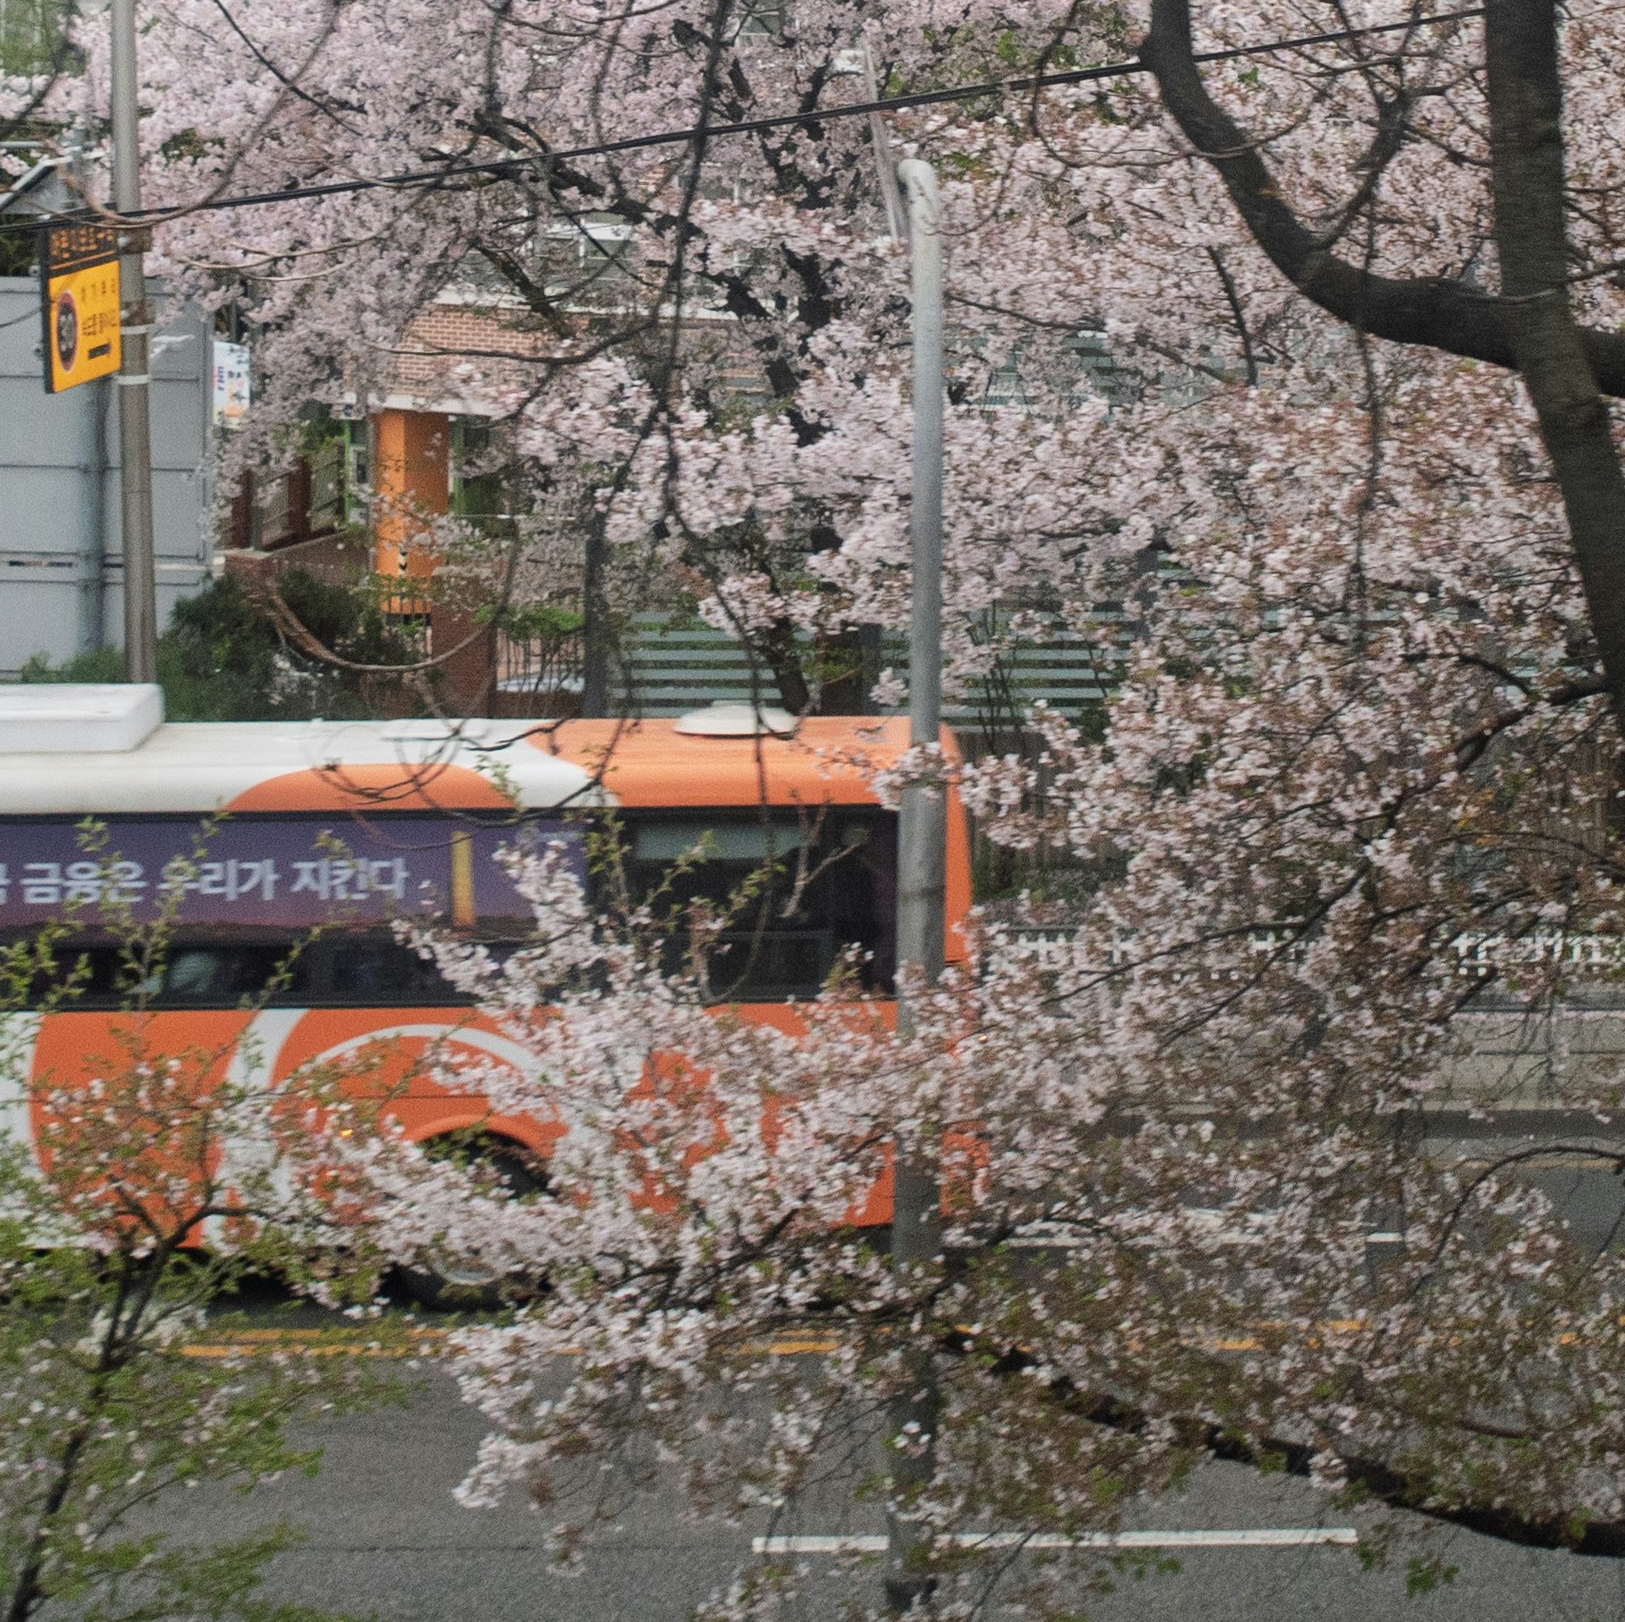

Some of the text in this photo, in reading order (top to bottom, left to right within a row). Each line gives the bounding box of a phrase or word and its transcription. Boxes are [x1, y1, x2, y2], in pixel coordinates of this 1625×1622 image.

[20, 860, 148, 905] 금융은
[157, 858, 280, 901] 우리가
[290, 857, 410, 901] 지킨다
